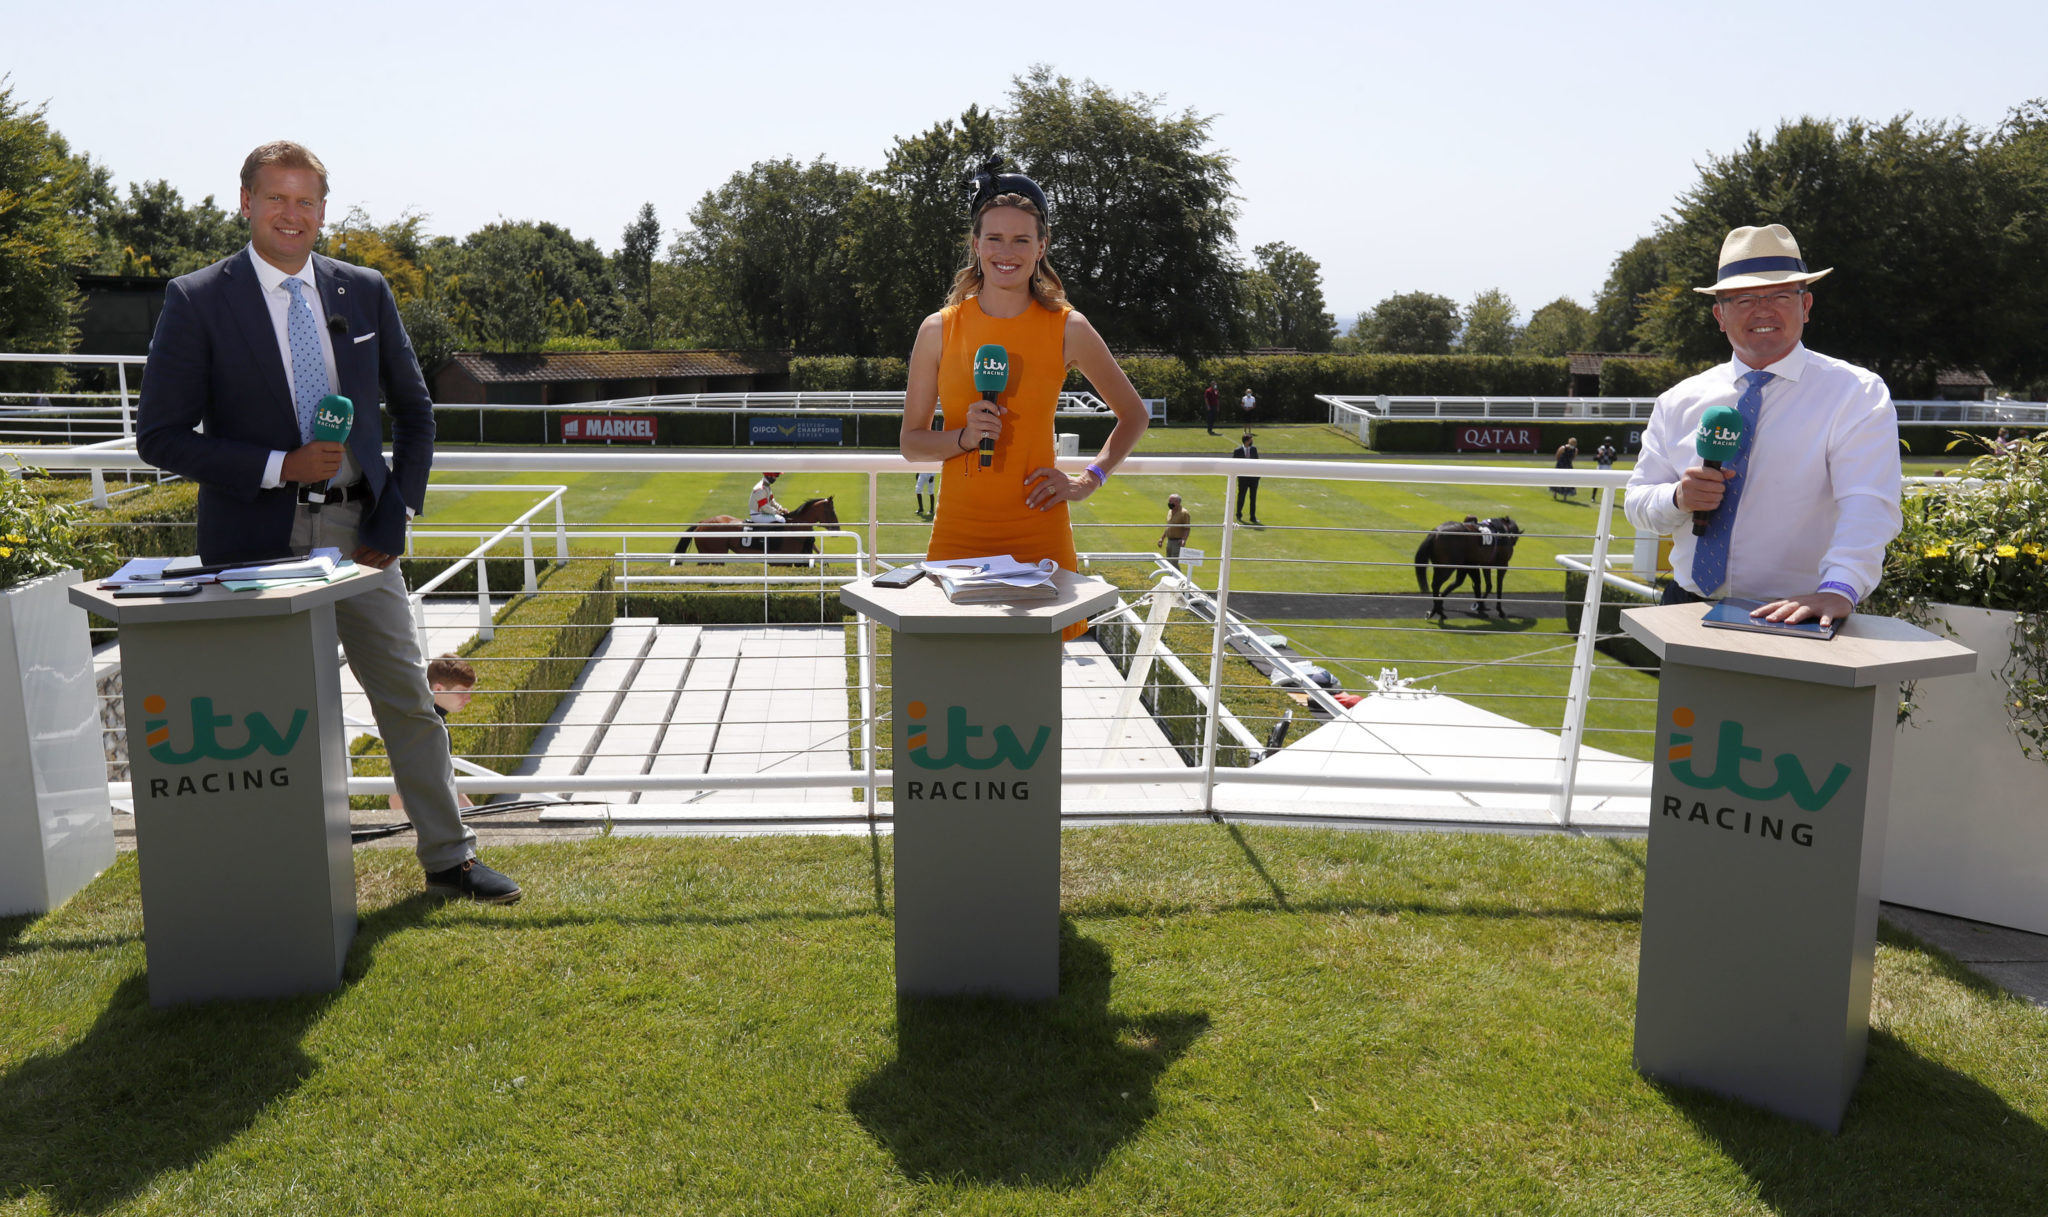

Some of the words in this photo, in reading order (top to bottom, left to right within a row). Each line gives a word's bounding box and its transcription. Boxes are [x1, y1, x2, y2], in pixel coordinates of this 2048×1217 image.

[984, 358, 1006, 370] itv
[319, 408, 344, 424] itv
[586, 419, 654, 437] MARKEL
[1715, 426, 1740, 440] itv
[1464, 429, 1531, 447] QATAR
[143, 693, 308, 765] itv
[907, 701, 1053, 770] itv
[1667, 706, 1852, 812] itv
[150, 767, 289, 799] RACING
[908, 781, 1030, 800] RACING
[1662, 794, 1814, 848] RACING
